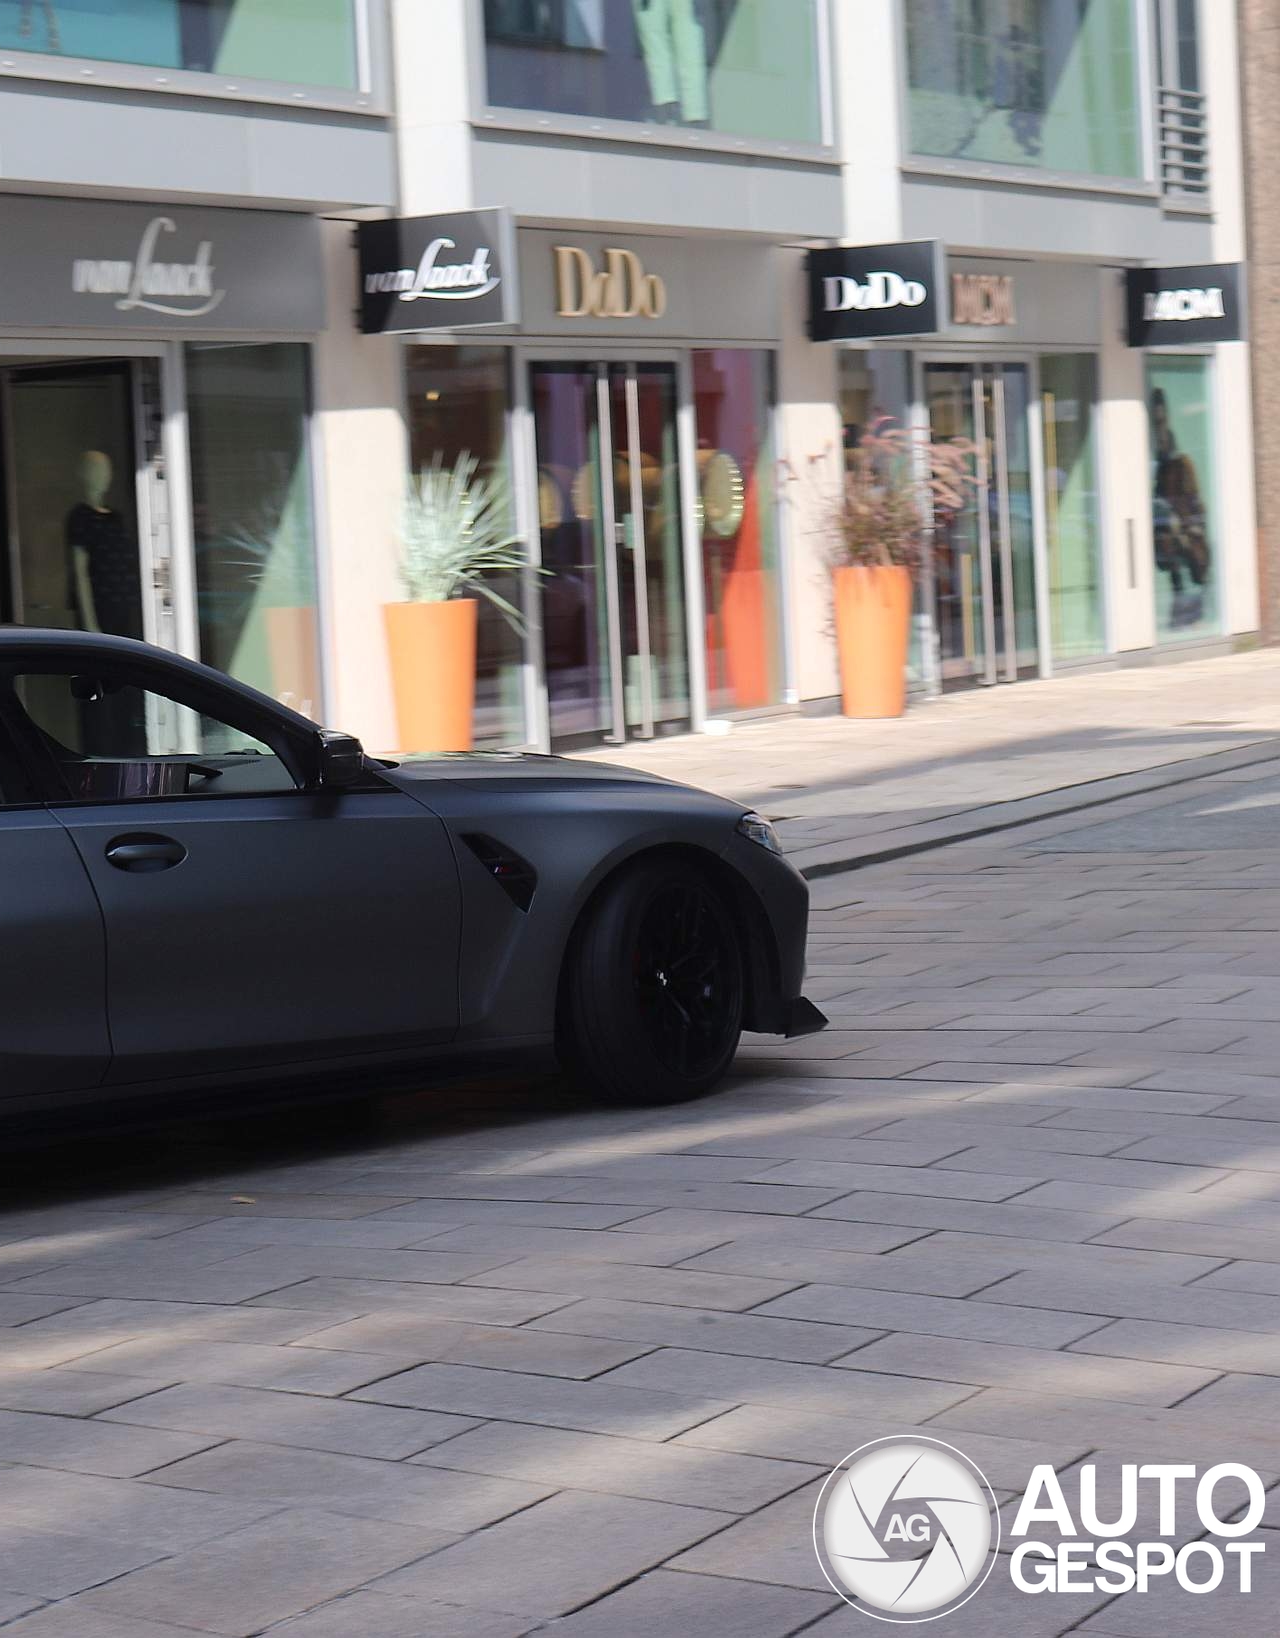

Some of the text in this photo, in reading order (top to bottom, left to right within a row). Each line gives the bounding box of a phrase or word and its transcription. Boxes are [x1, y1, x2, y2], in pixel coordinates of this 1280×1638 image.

[72, 258, 131, 293] van
[365, 268, 417, 293] van
[1142, 287, 1226, 321] MCM
